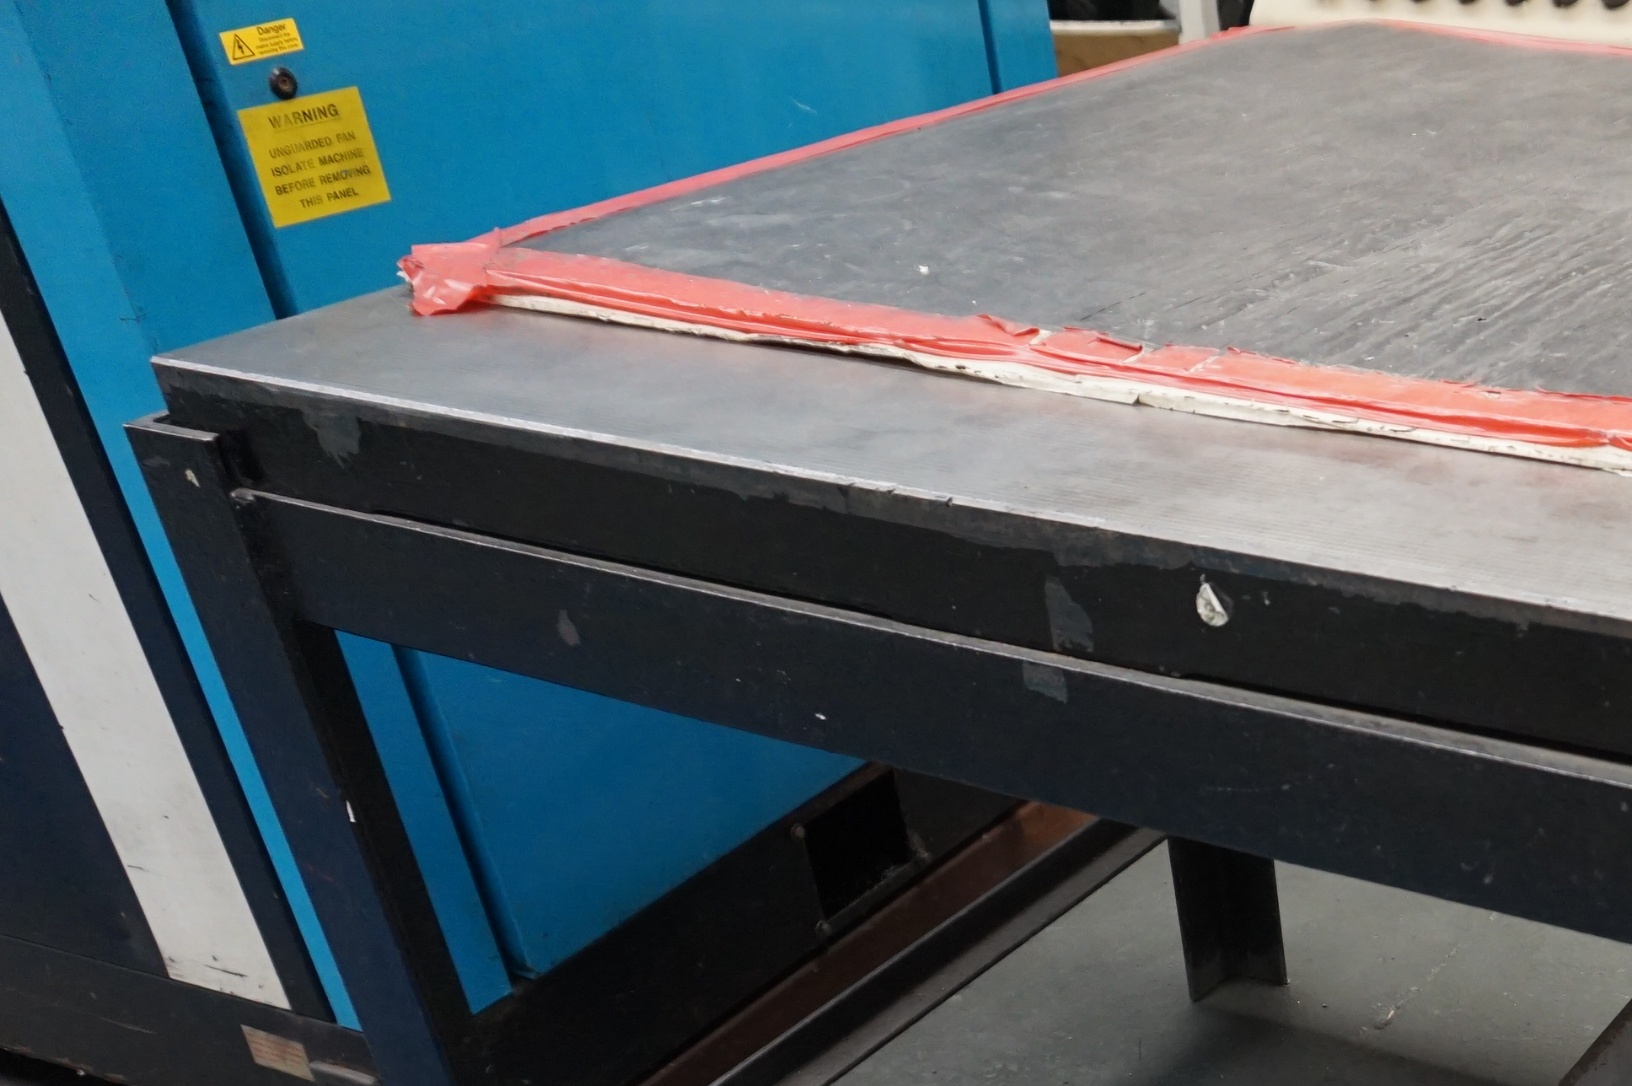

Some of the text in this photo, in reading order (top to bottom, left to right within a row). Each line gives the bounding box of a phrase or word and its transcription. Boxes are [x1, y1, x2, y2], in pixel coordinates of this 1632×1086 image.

[256, 23, 286, 35] Danger
[268, 103, 340, 129] WARNING
[269, 131, 356, 159] UNGUARDED FAN
[271, 147, 365, 177] ISOLATE MACHINE
[275, 164, 371, 196] BEFORE REMOVING
[299, 187, 359, 209] THIS PANEL
